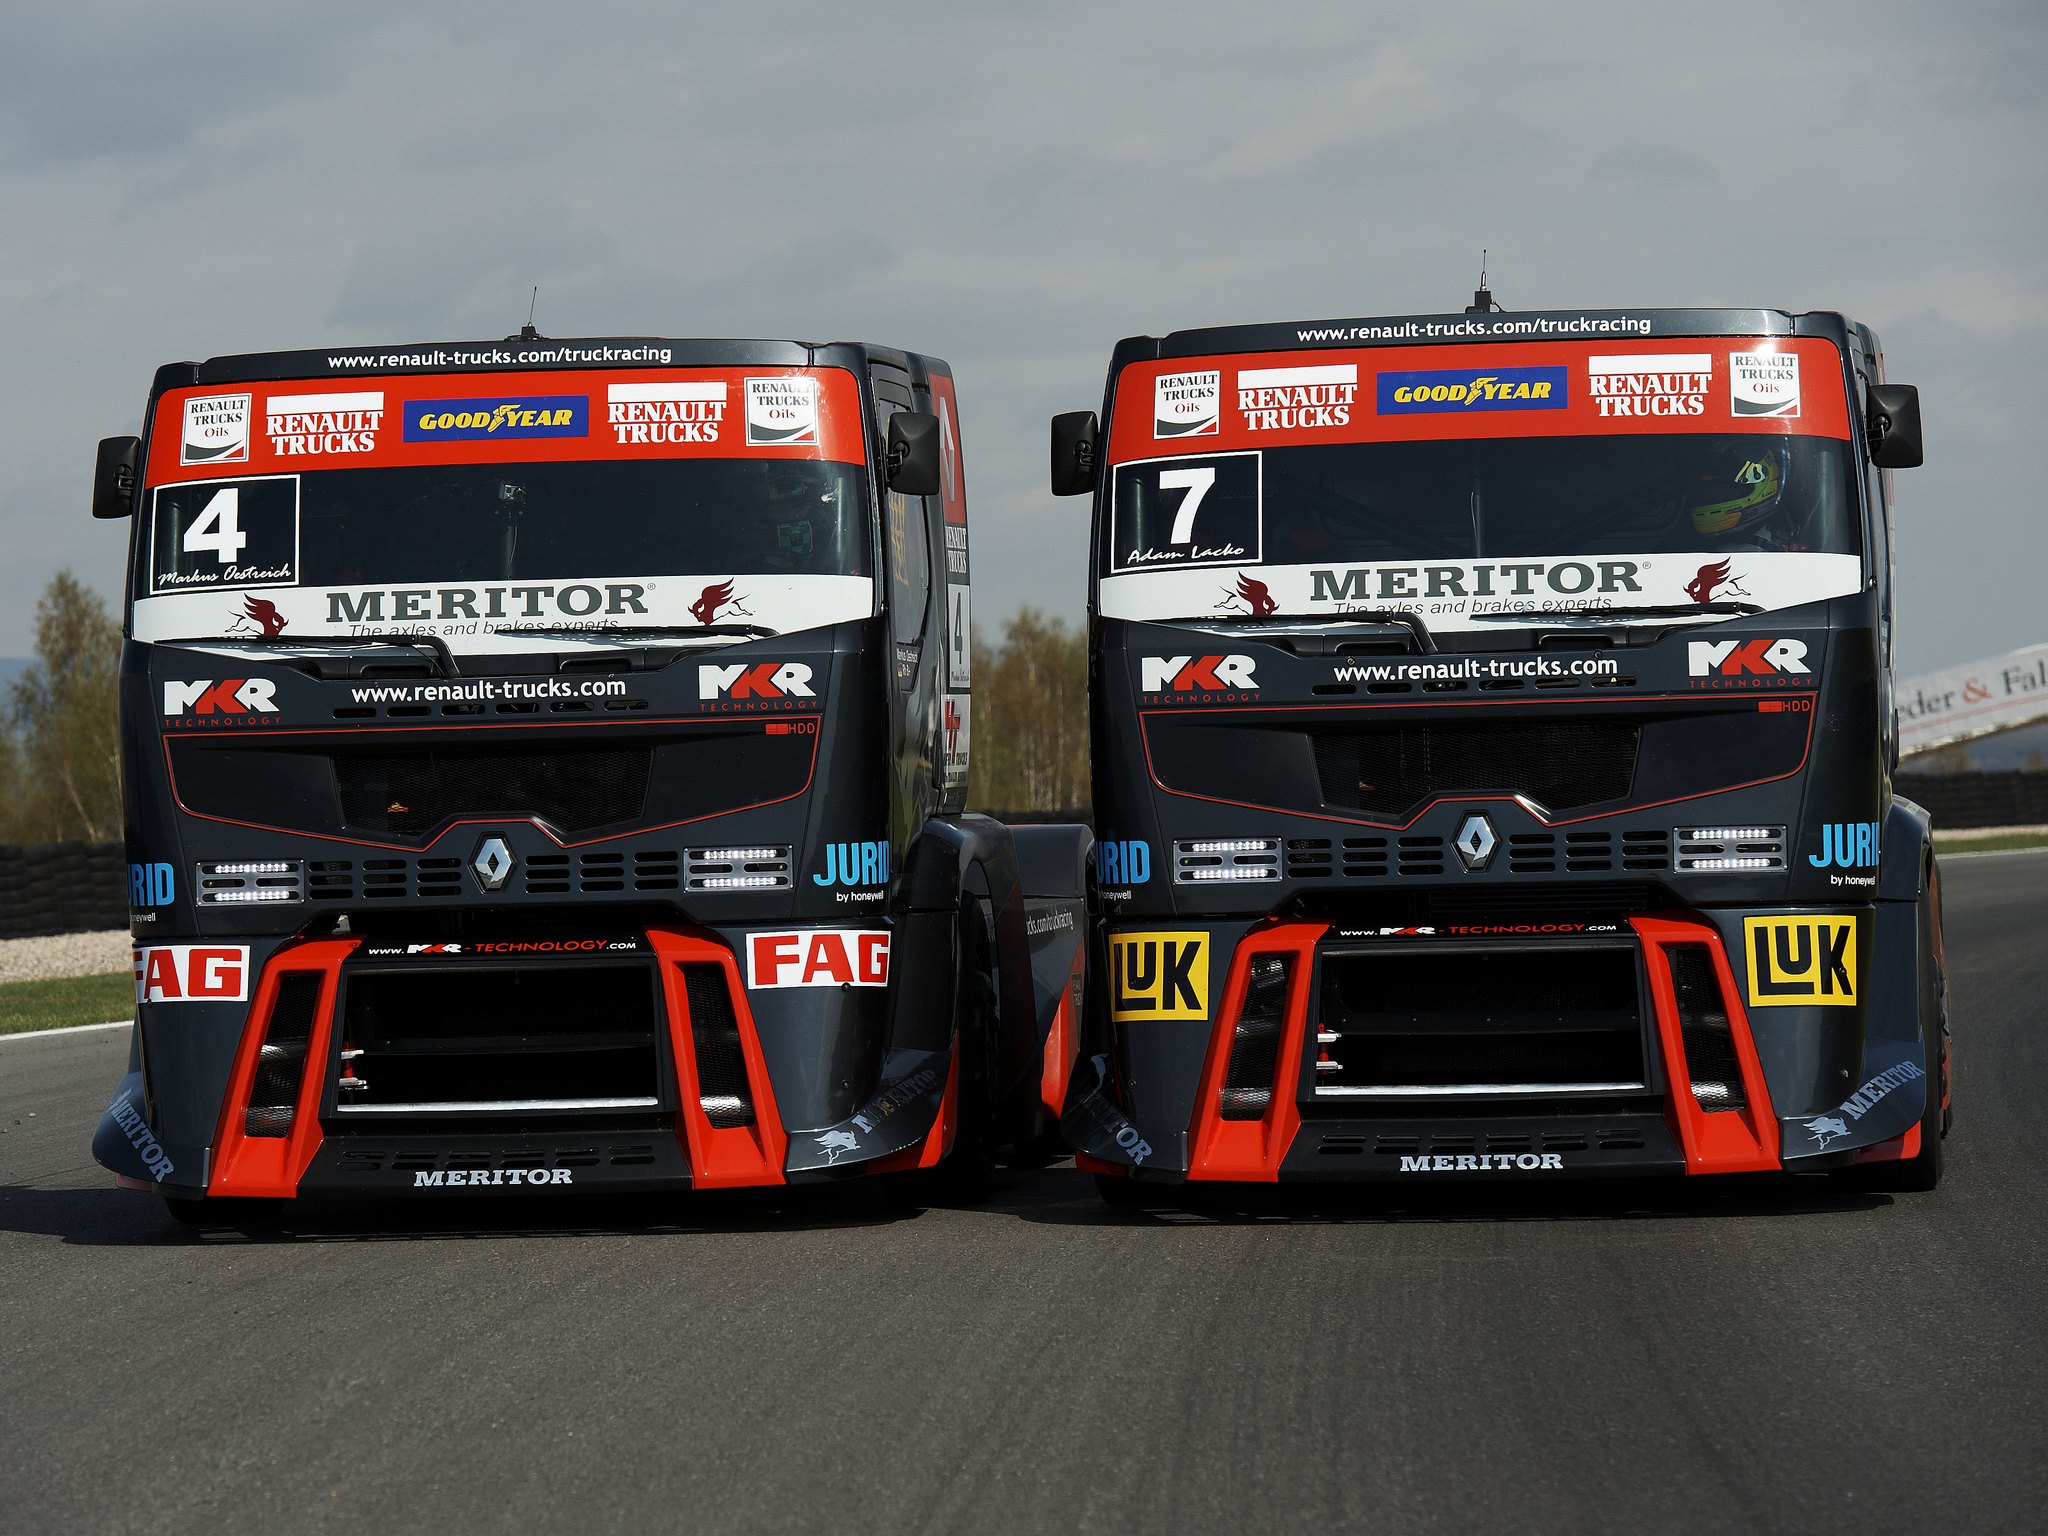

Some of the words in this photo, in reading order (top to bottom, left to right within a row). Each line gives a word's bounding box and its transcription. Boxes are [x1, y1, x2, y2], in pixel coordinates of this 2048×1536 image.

[1297, 316, 1651, 342] www.renault-trucks.com/truckracing
[328, 346, 672, 369] www.renault-trucks.com/truckracing
[1735, 356, 1795, 367] RENAULT
[1160, 374, 1218, 389] RENAULT
[1589, 374, 1712, 397] RENAULT
[1740, 369, 1793, 380] TRUCKS
[1163, 387, 1215, 401] TRUCKS
[1238, 384, 1358, 411] RENAULT
[1753, 383, 1780, 393] Oils
[190, 399, 247, 415] RENAULT
[757, 395, 809, 406] TRUCKS
[1175, 402, 1200, 414] Oils
[1596, 395, 1705, 417] TRUCKS
[194, 412, 243, 426] TRUCKS
[266, 411, 384, 436] RENAULT
[607, 401, 727, 424] RENAULT
[769, 408, 796, 419] Oils
[1244, 407, 1350, 431] TRUCKS
[204, 426, 229, 438] Oils
[613, 421, 719, 444] TRUCKS
[272, 432, 376, 456] TRUCKS
[1160, 468, 1215, 544] 7
[183, 488, 247, 563] 4
[1127, 547, 1185, 565] Adam
[1190, 541, 1246, 561] Lacko
[158, 569, 219, 585] Markus
[223, 563, 292, 583] Oestreich
[1310, 562, 1642, 602] MERITOR
[325, 583, 649, 623] MERITOR
[1334, 603, 1367, 614] The
[1375, 602, 1424, 615] axles
[1431, 600, 1465, 614] and
[1472, 598, 1535, 613] brakes
[1542, 597, 1612, 613] experts
[349, 624, 383, 637] The
[390, 623, 437, 637] axles
[443, 622, 477, 635] and
[483, 620, 544, 635] brakes
[954, 592, 963, 665] 4
[1334, 656, 1618, 682] www.renault-trucks.com
[1688, 639, 1812, 677] MKR
[699, 663, 816, 700] MKR
[1142, 655, 1260, 692] MKR
[1690, 677, 1812, 690] TECHNOLOGY
[164, 678, 279, 715] MKR
[351, 678, 626, 703] www.renault-trucks.com
[1143, 692, 1261, 704] TECHNOLOGY
[700, 700, 817, 712] TECHNOLOGY
[1782, 700, 1811, 713] HDD
[165, 716, 281, 728] TECHNOLOGY
[788, 722, 816, 735] HDD
[813, 841, 889, 886] JURID
[129, 862, 175, 906] RID
[1830, 875, 1844, 887] by
[836, 892, 850, 904] by
[851, 890, 884, 902] honeywell
[754, 934, 889, 986] FAG
[1840, 1060, 1926, 1120] MERITOR
[110, 1099, 174, 1183] MERITOR
[1400, 1153, 1564, 1172] MERITOR
[414, 1168, 573, 1187] MERITOR
